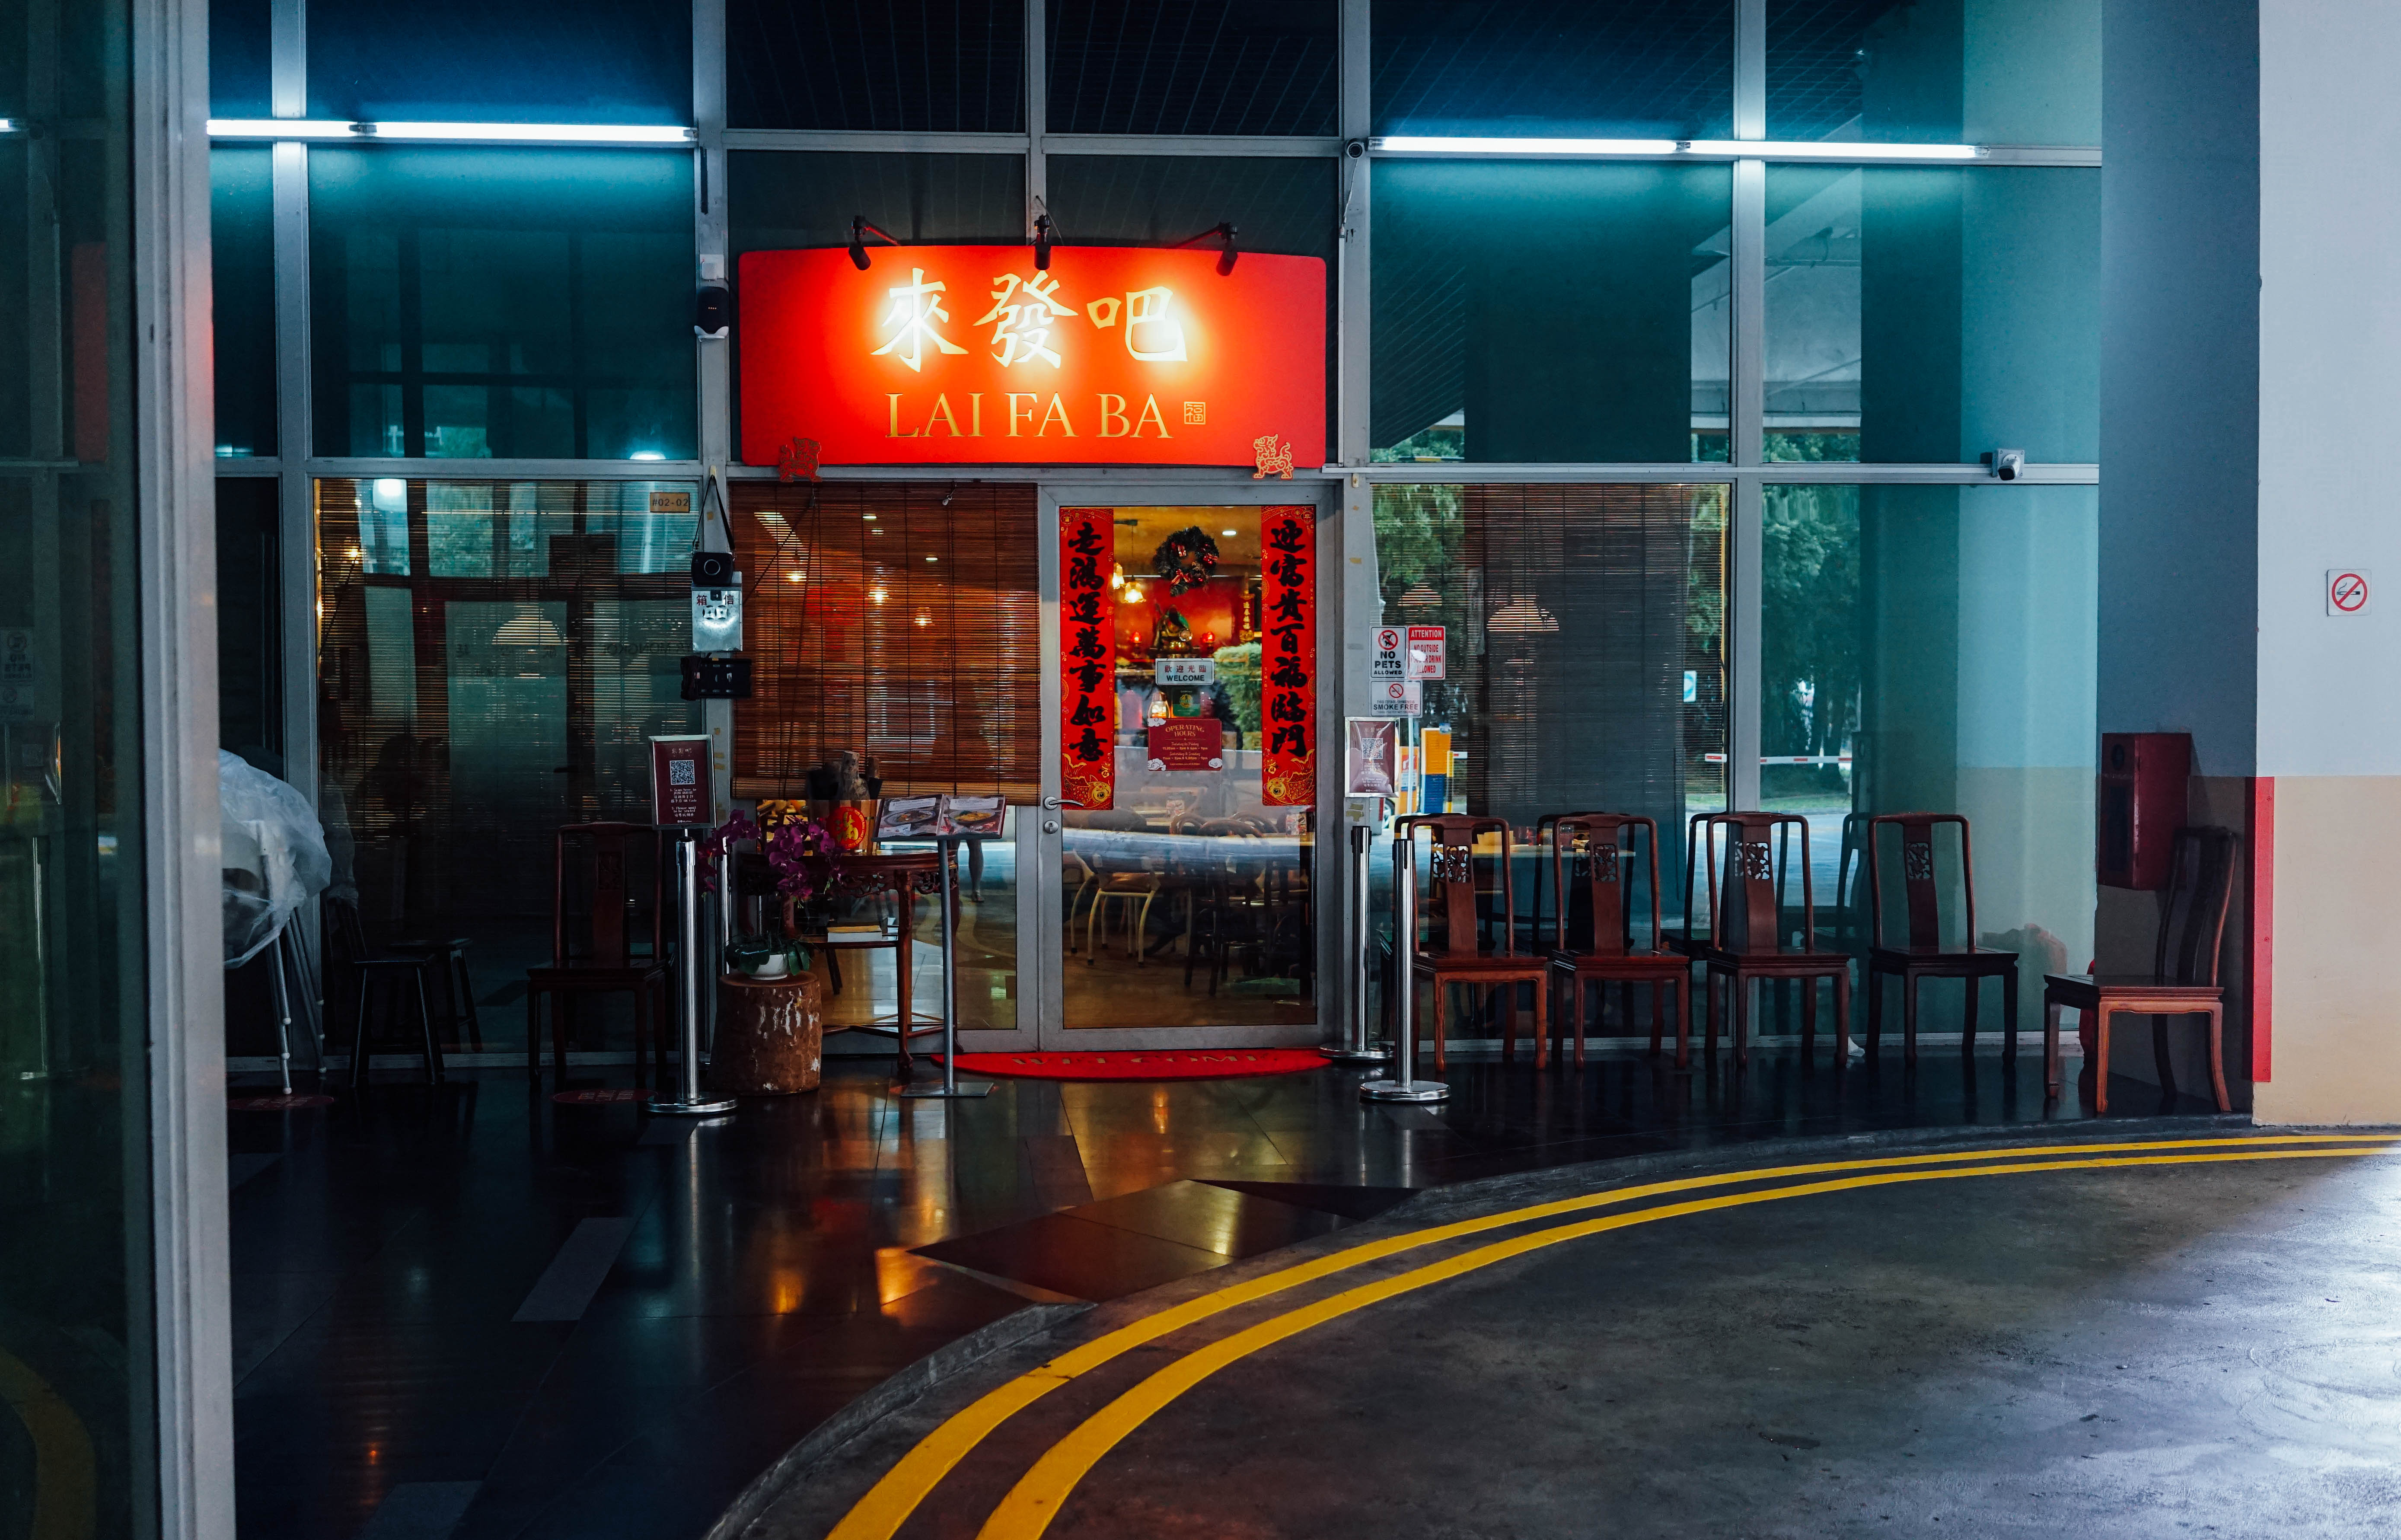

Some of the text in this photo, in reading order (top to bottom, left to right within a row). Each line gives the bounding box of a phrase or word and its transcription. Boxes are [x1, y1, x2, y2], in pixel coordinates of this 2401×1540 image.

[871, 268, 1187, 372] 來發吧
[886, 392, 1174, 439] LAI FA BA
[652, 498, 689, 507] #02-02
[1165, 724, 1205, 733] OPERATING
